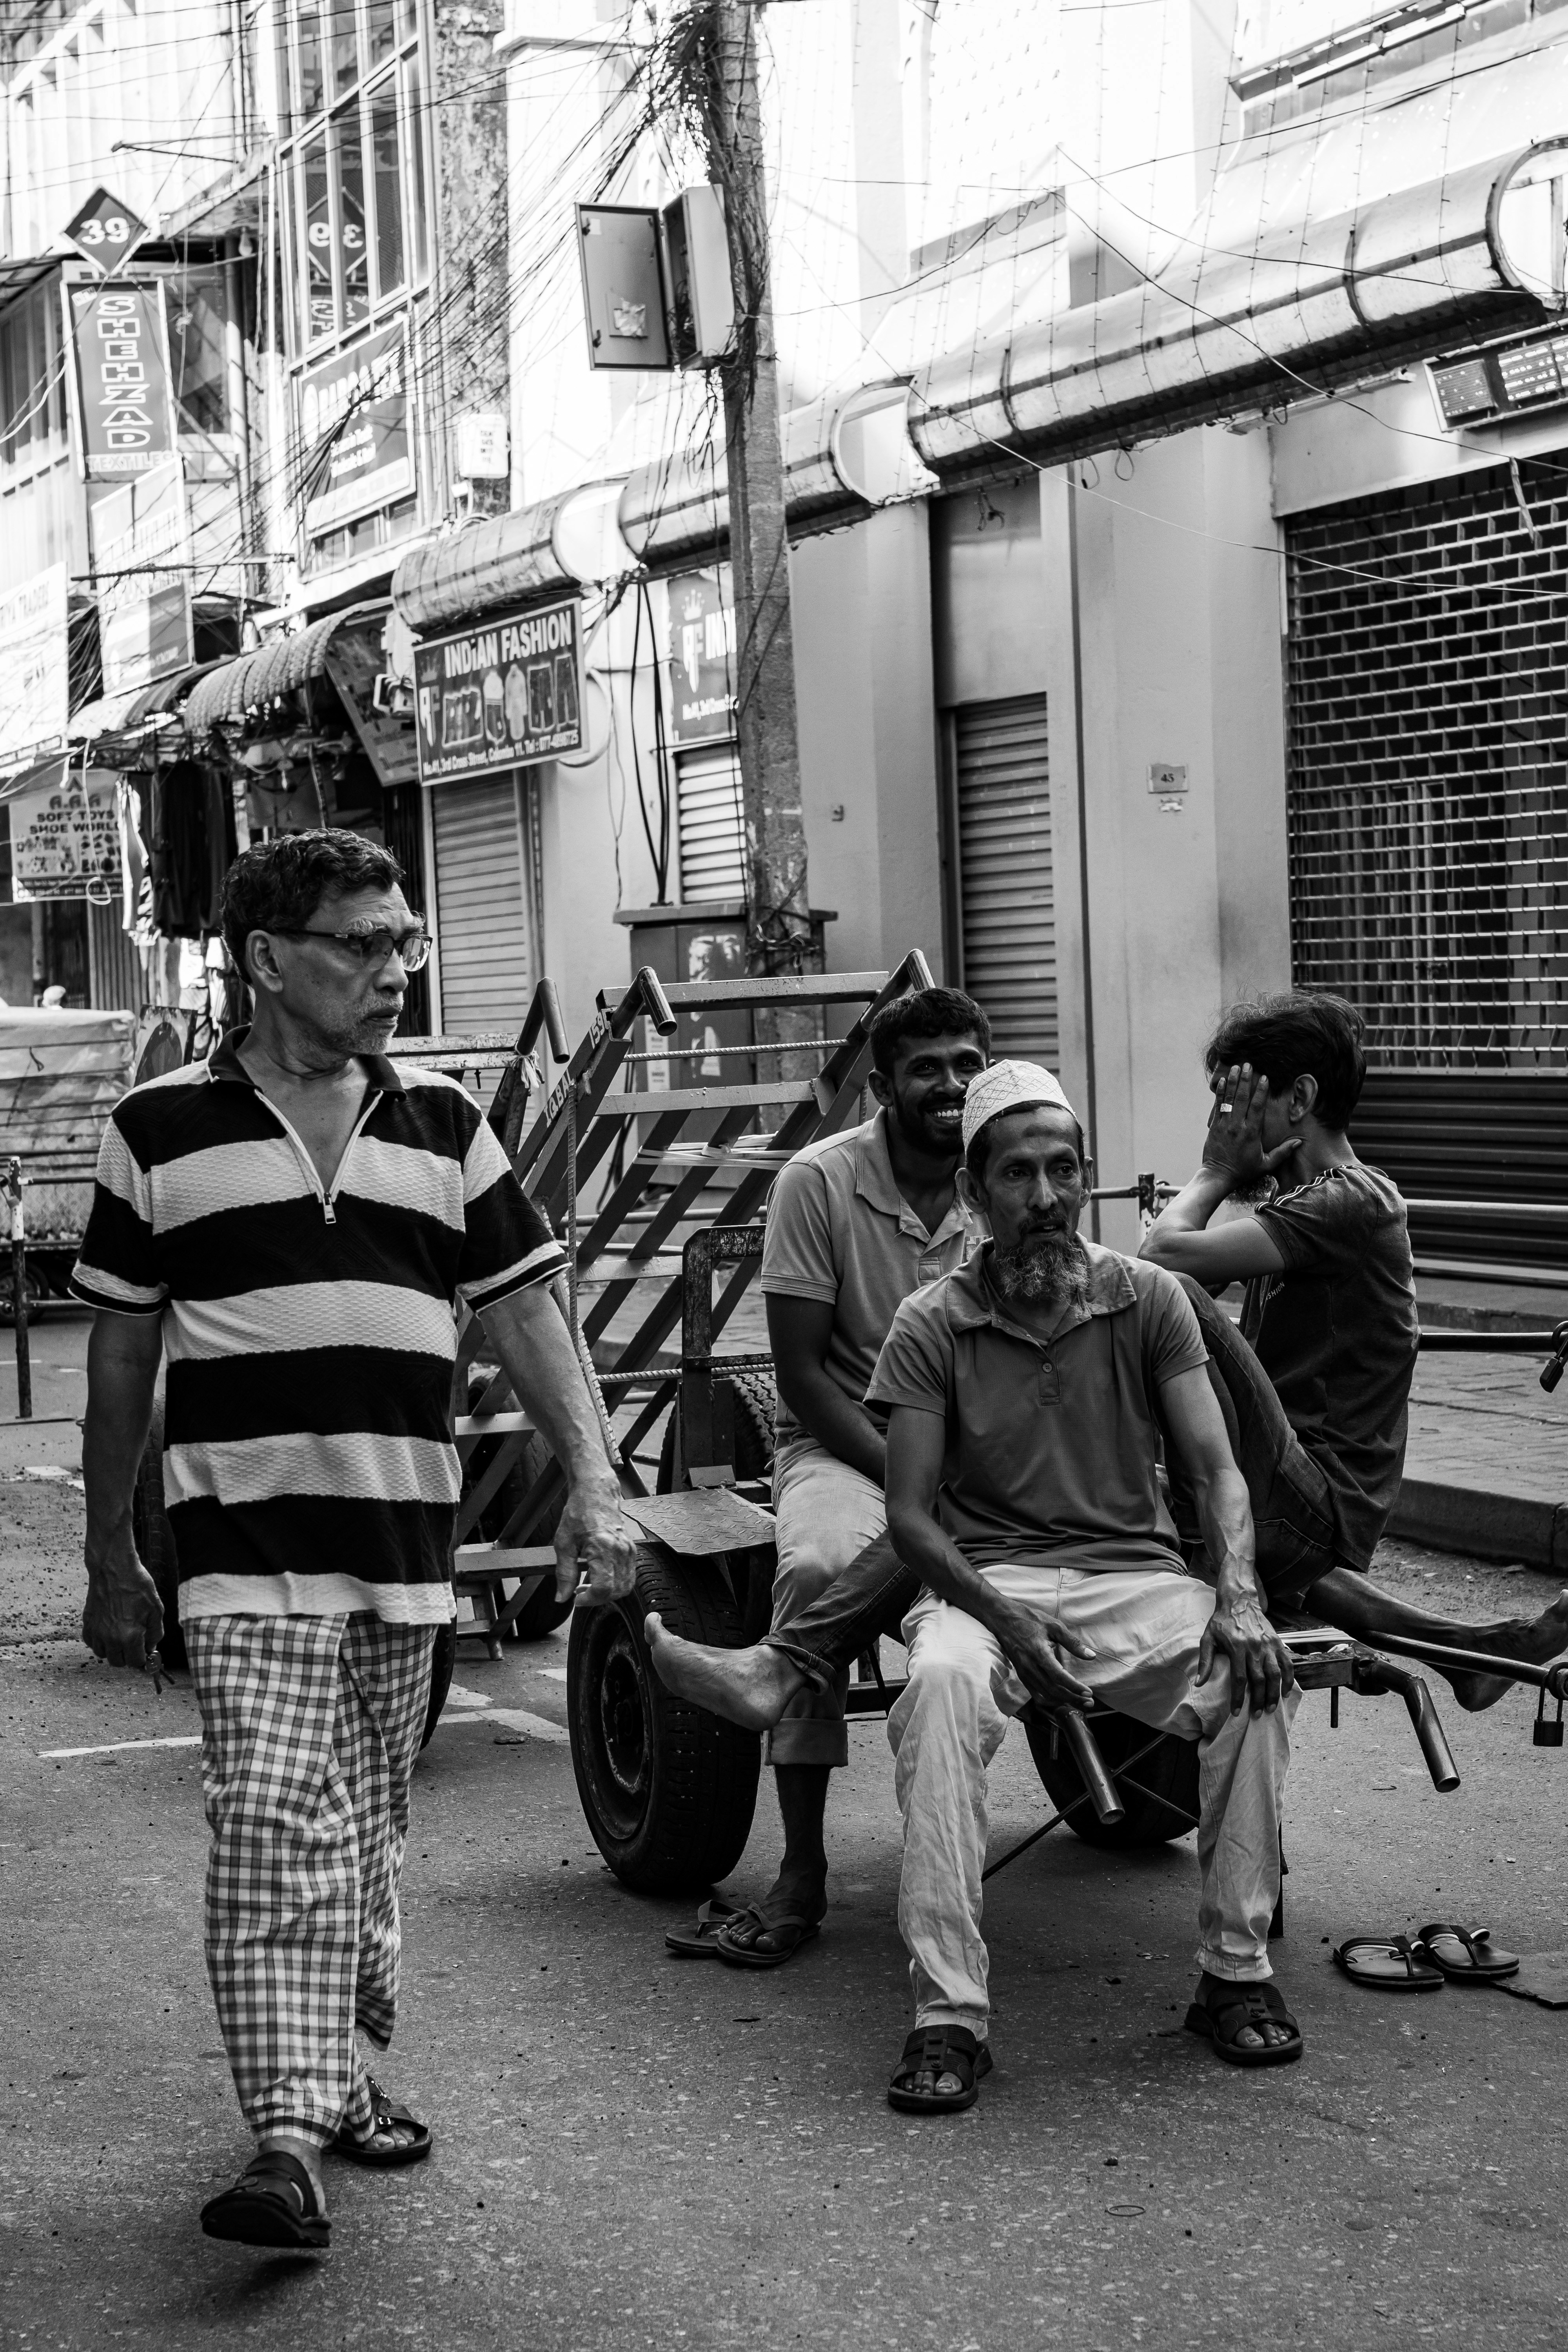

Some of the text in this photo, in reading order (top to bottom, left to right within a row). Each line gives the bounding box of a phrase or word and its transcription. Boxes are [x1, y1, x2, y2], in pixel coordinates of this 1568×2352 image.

[80, 217, 130, 245] 39
[96, 295, 153, 448] SHEHZAD
[88, 450, 173, 472] TEXTILES
[501, 610, 573, 663] FASHION
[1161, 773, 1174, 783] 45
[37, 811, 72, 823] SOFT
[30, 824, 68, 835] SHOE
